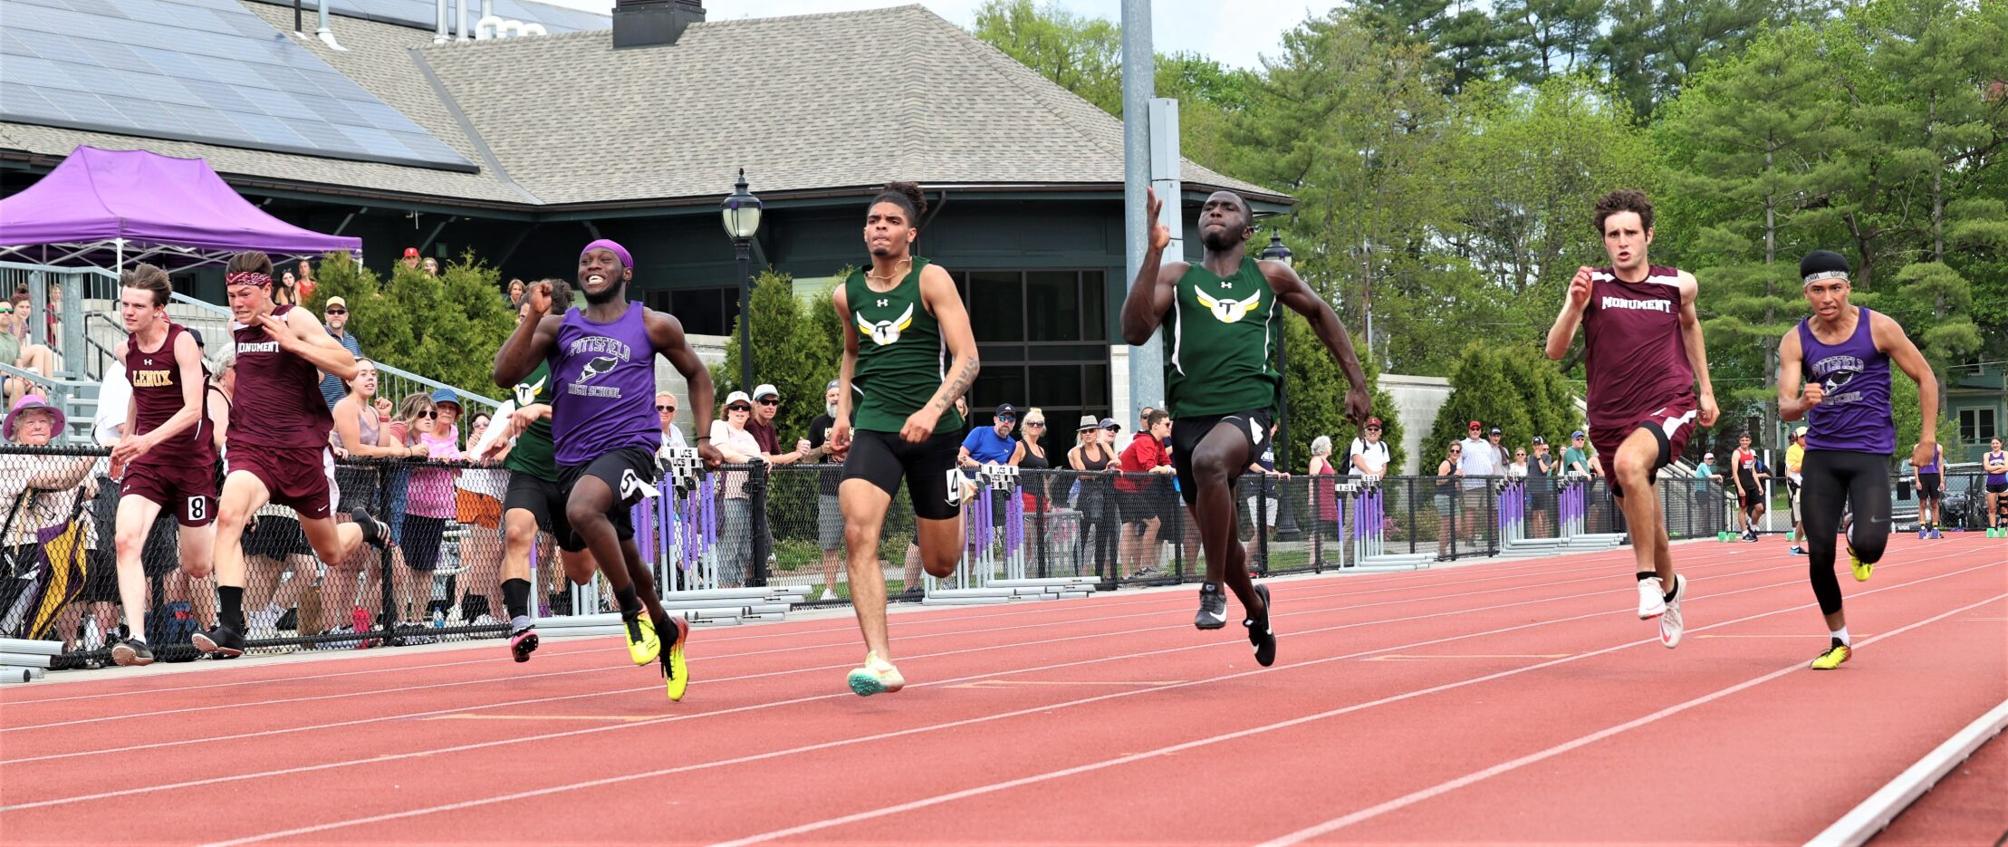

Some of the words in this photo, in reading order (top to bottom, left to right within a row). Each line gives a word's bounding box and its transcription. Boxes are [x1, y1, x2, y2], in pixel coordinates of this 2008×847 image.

[1602, 296, 1671, 313] MONUMENT
[237, 341, 279, 355] ONUMENT
[570, 336, 631, 363] PITTSFIELD
[132, 369, 173, 387] LENOX
[568, 383, 588, 397] HIGH
[588, 385, 622, 399] SCHOOL
[620, 472, 637, 494] 5
[950, 470, 959, 497] 4
[191, 497, 204, 519] 8
